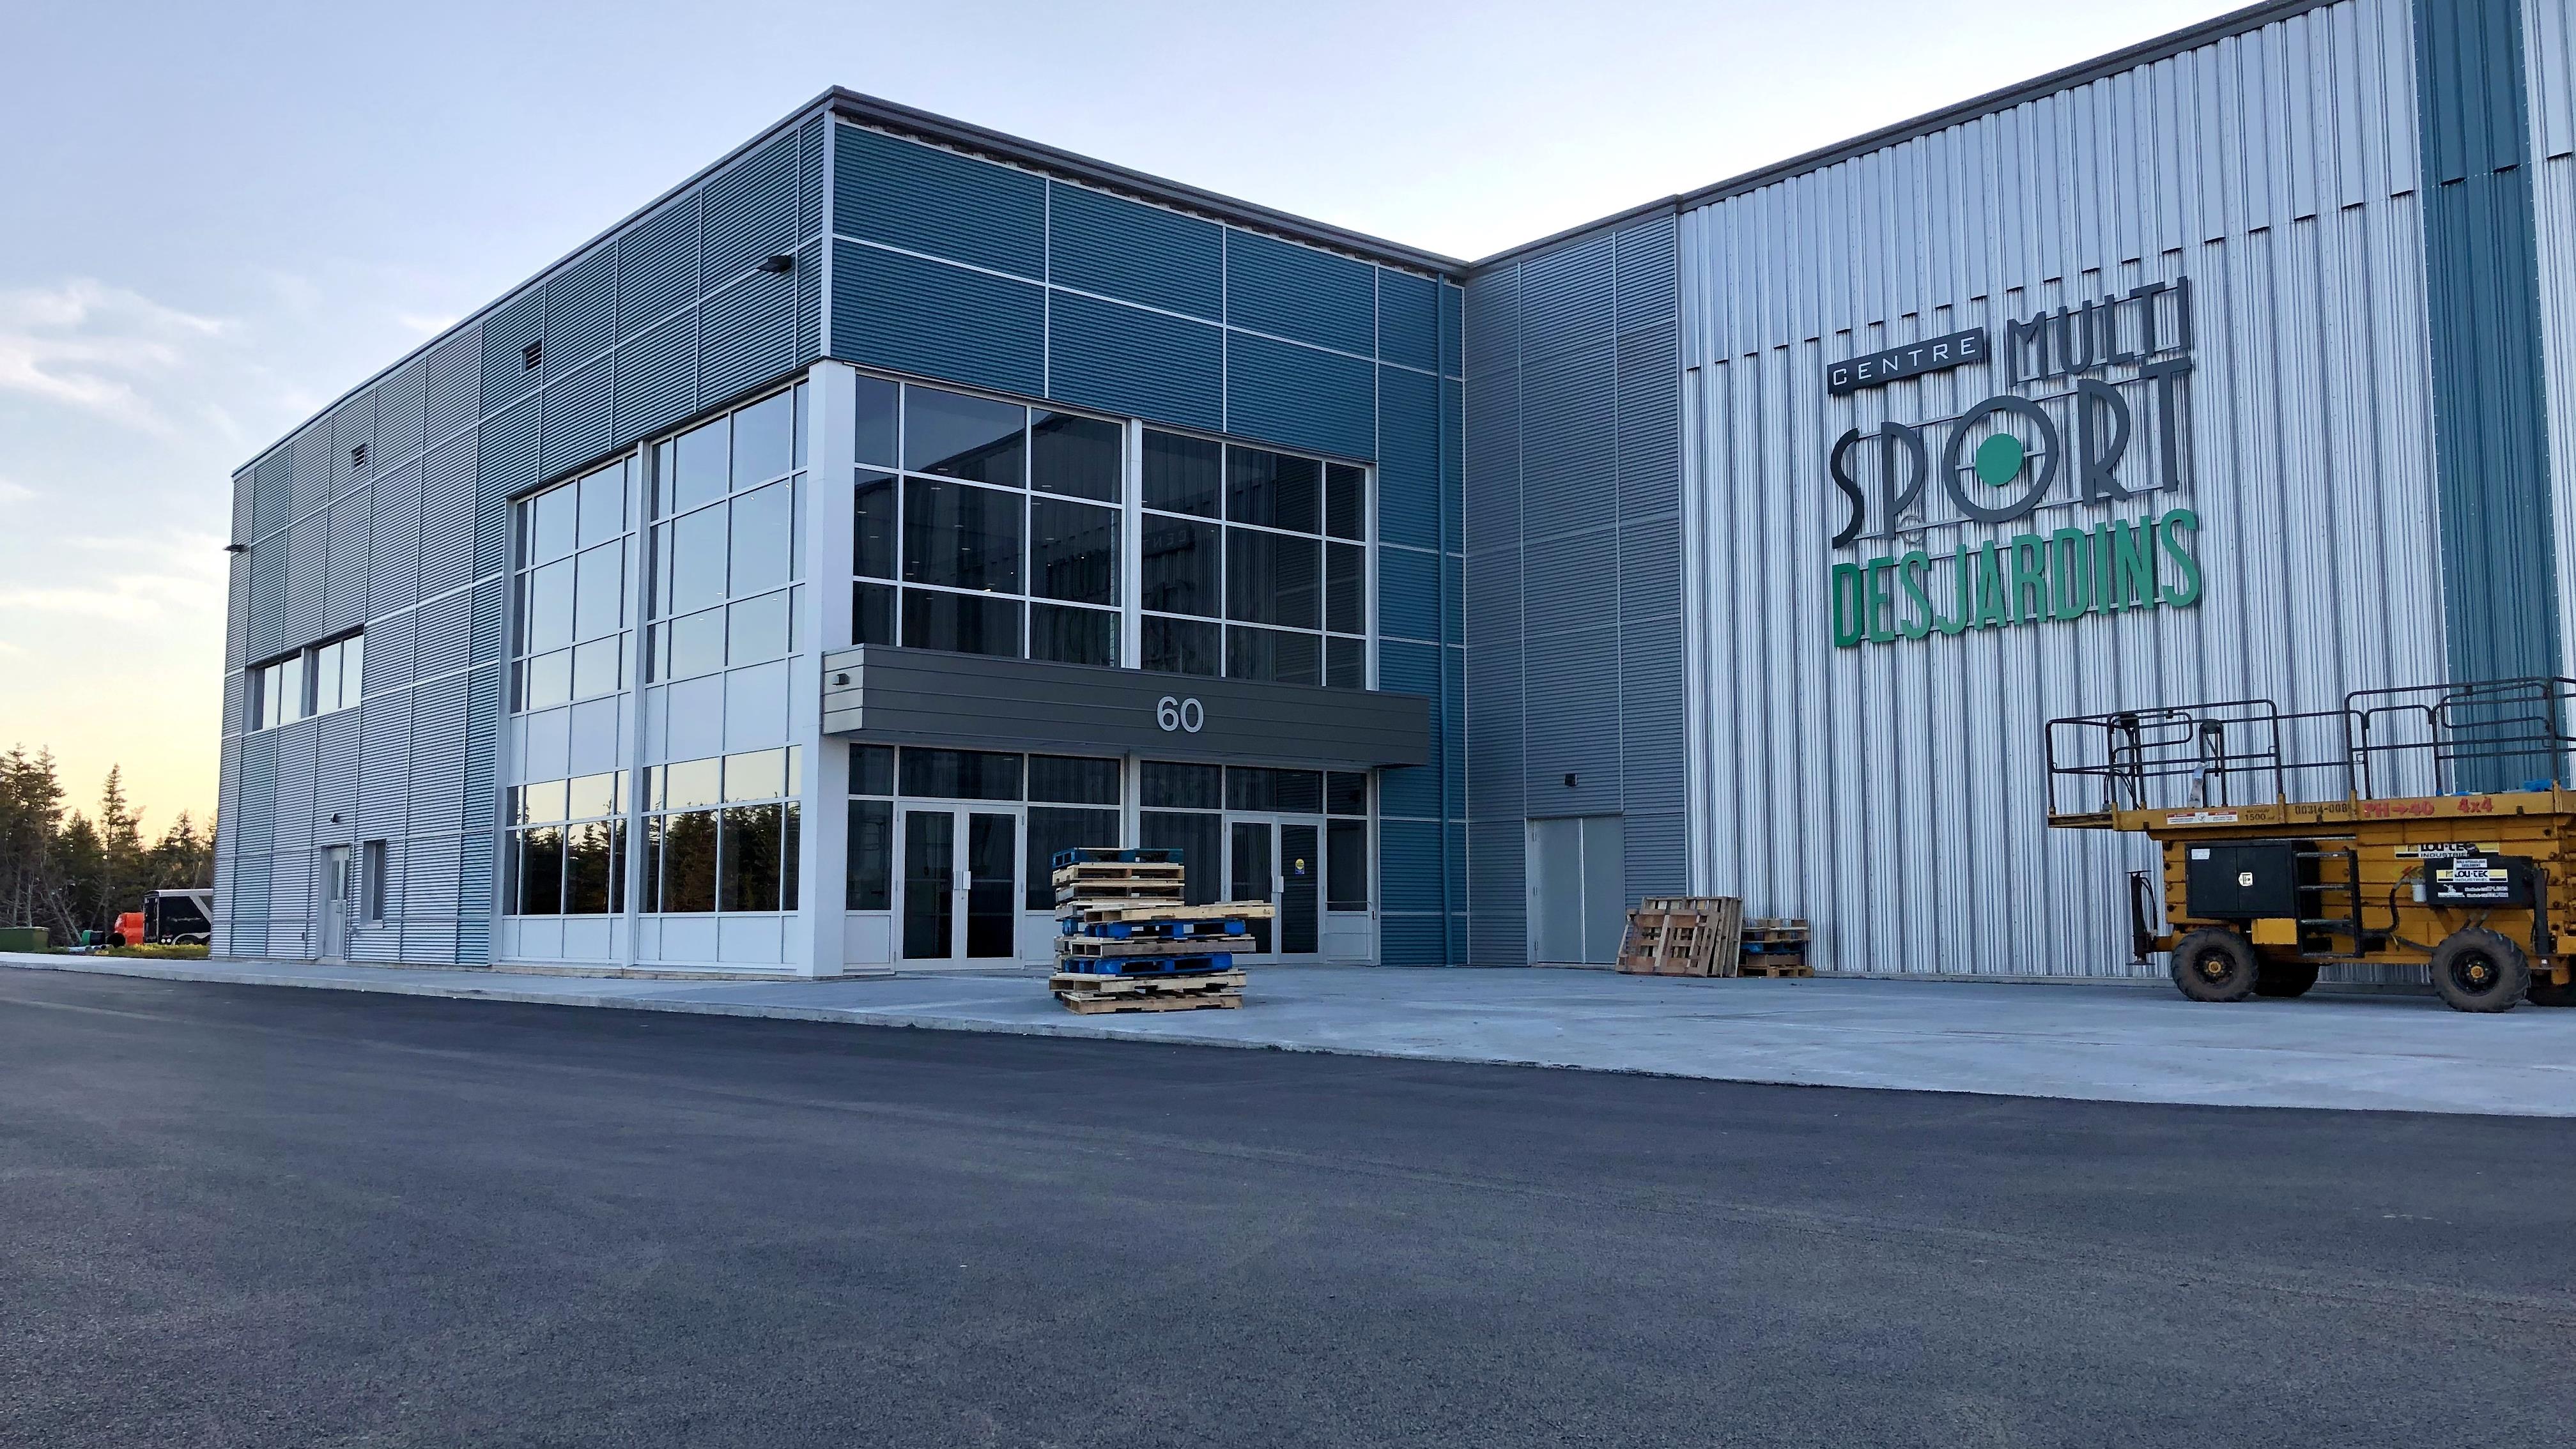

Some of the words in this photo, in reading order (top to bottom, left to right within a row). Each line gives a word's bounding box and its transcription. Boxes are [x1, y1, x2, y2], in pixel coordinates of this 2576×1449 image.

[1832, 336, 1976, 386] CENTRE
[2007, 276, 2191, 387] MULTI
[1830, 356, 2192, 549] SPORT
[1832, 509, 2200, 648] DESJARDINS
[1157, 696, 1204, 733] 60
[2457, 797, 2494, 813] 4x4
